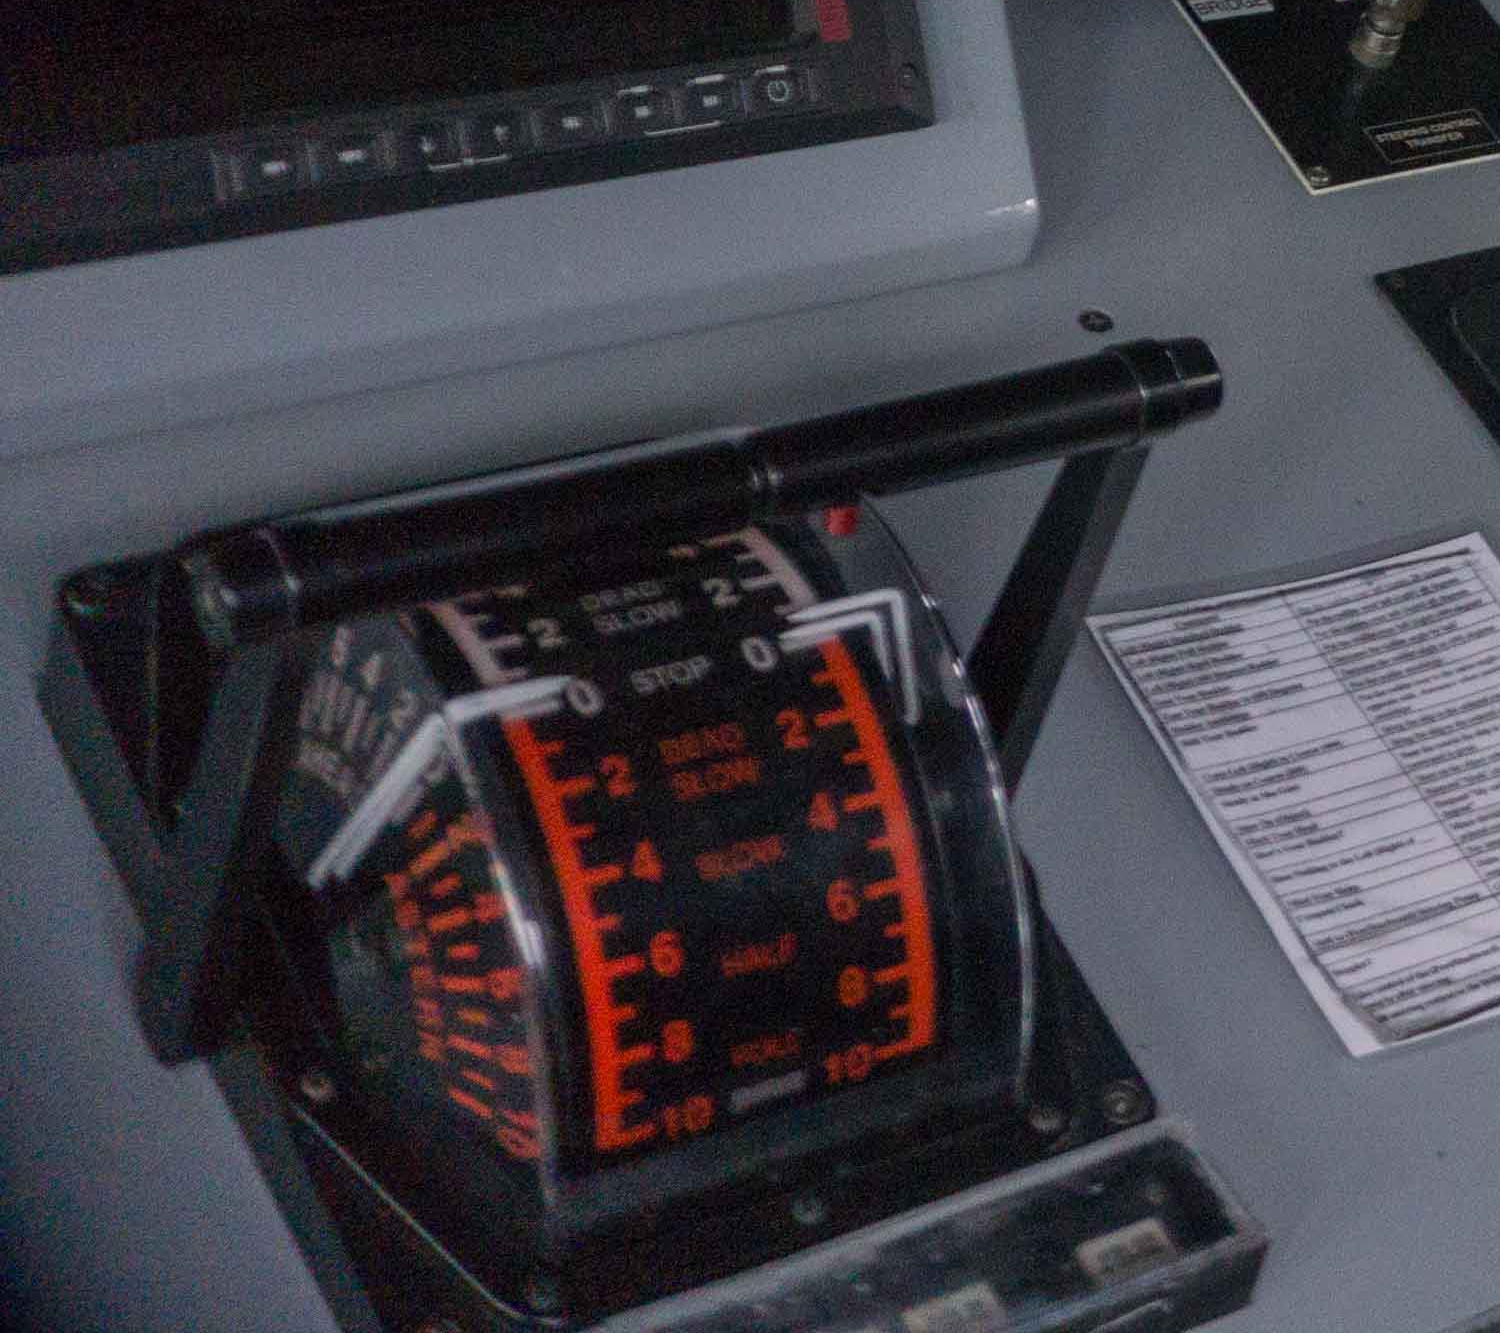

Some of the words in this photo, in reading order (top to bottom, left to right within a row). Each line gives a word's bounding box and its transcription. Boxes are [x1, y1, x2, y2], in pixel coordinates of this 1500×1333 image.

[701, 577, 741, 609] 2
[565, 678, 604, 717] 0
[630, 654, 712, 695] STOP
[740, 635, 779, 673] 0
[599, 752, 640, 799] 2
[775, 707, 812, 750] 2
[630, 837, 664, 881] 4
[806, 790, 840, 832] 4
[649, 929, 685, 979] 6
[826, 877, 861, 924] 6
[661, 1017, 697, 1064] 8
[836, 965, 870, 1009] 8
[660, 1094, 718, 1140] 10
[822, 1044, 875, 1085] 10
